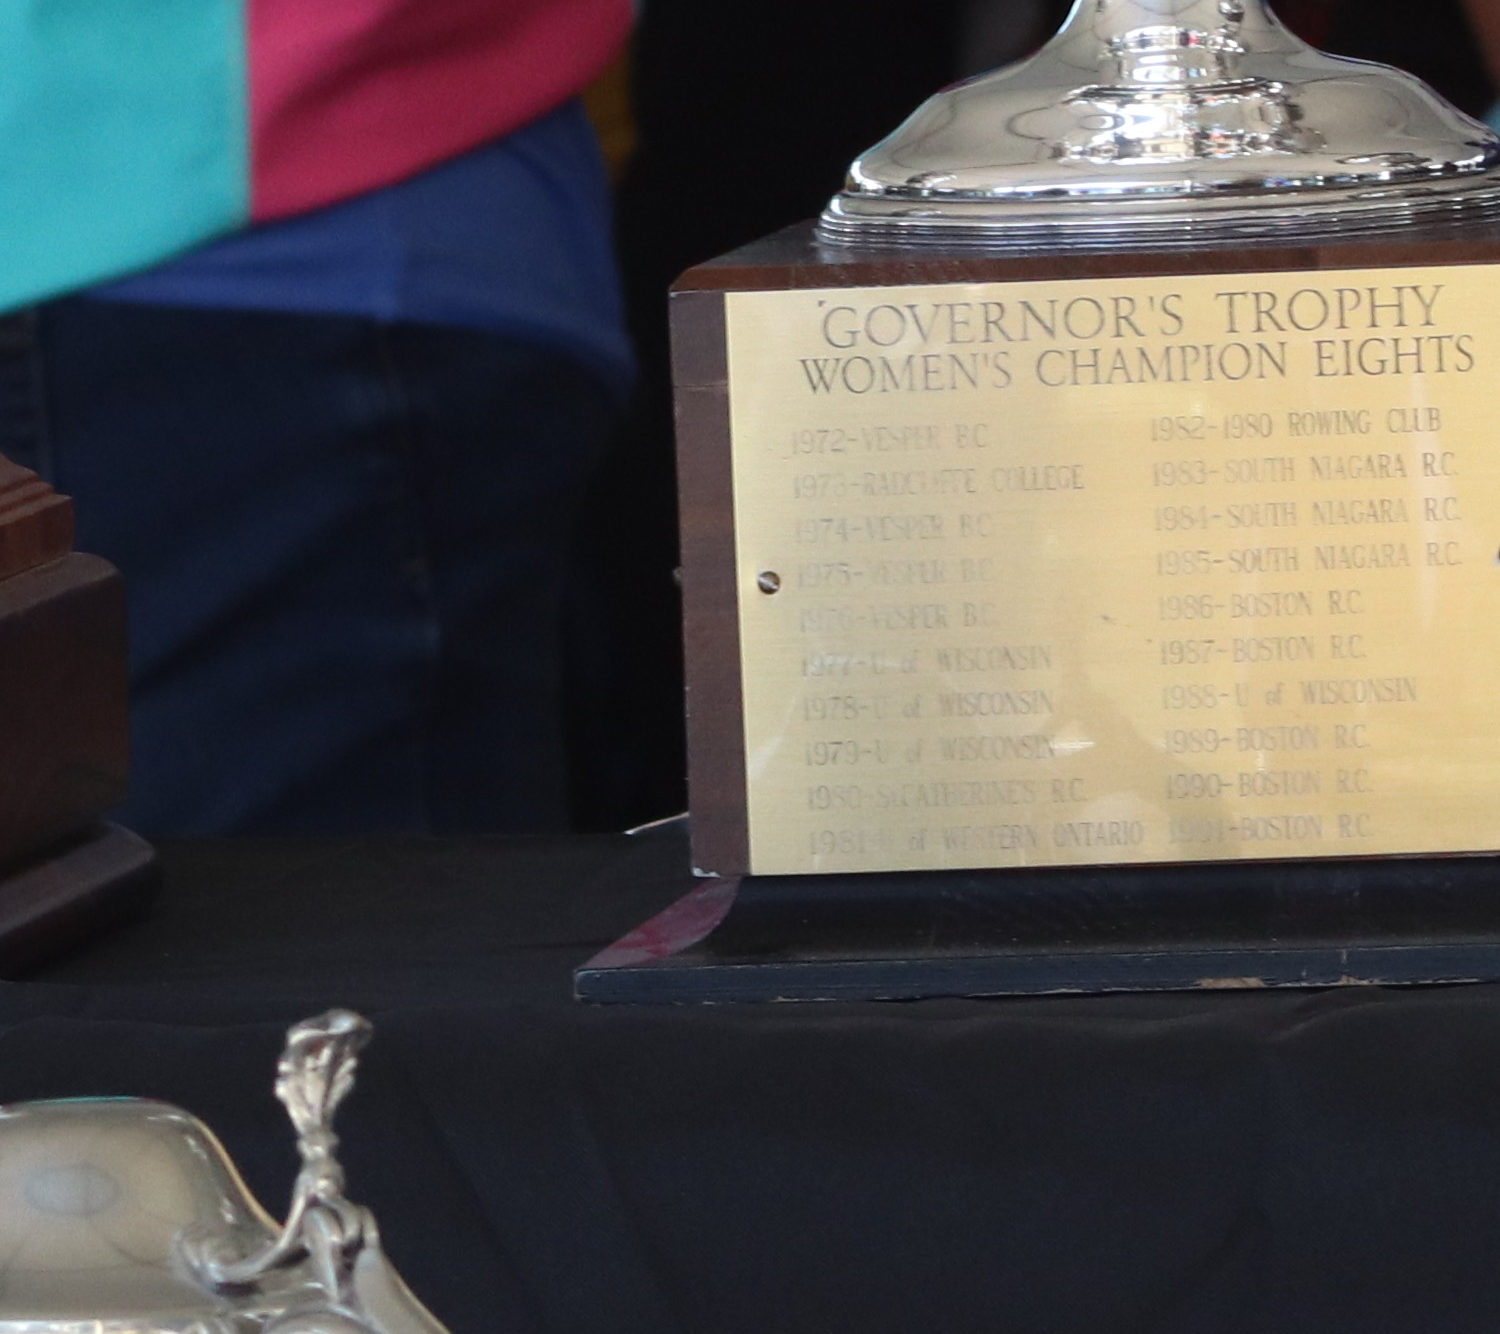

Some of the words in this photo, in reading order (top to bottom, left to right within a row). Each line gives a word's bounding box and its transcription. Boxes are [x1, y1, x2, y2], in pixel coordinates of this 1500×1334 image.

[822, 293, 1185, 350] GOVERNOR'S
[1215, 284, 1445, 330] TROPHY
[800, 349, 1012, 396] WOMEN'S
[1037, 340, 1288, 387] CHAMPION
[1315, 333, 1476, 378] EIGHTS
[1288, 409, 1371, 437] ROWING
[1387, 407, 1443, 433] CLUB
[991, 464, 1084, 492] COLLEGE
[1152, 456, 1296, 486] 1983-SOUTH
[1310, 453, 1408, 481] NIAGARA
[1312, 498, 1409, 526] NIAGARA
[1314, 544, 1411, 571] NIAGARA
[1159, 592, 1313, 621] 1986-BOSTON
[938, 644, 1053, 672] WISCONSIN
[1161, 637, 1315, 665] 1987-BOSTON
[940, 689, 1054, 717] WISCONSIN
[1266, 682, 1285, 706] of
[1300, 676, 1417, 705] WISCONSIN
[942, 733, 1057, 761] WISCONSIN
[1053, 820, 1145, 847] ONTARIO
